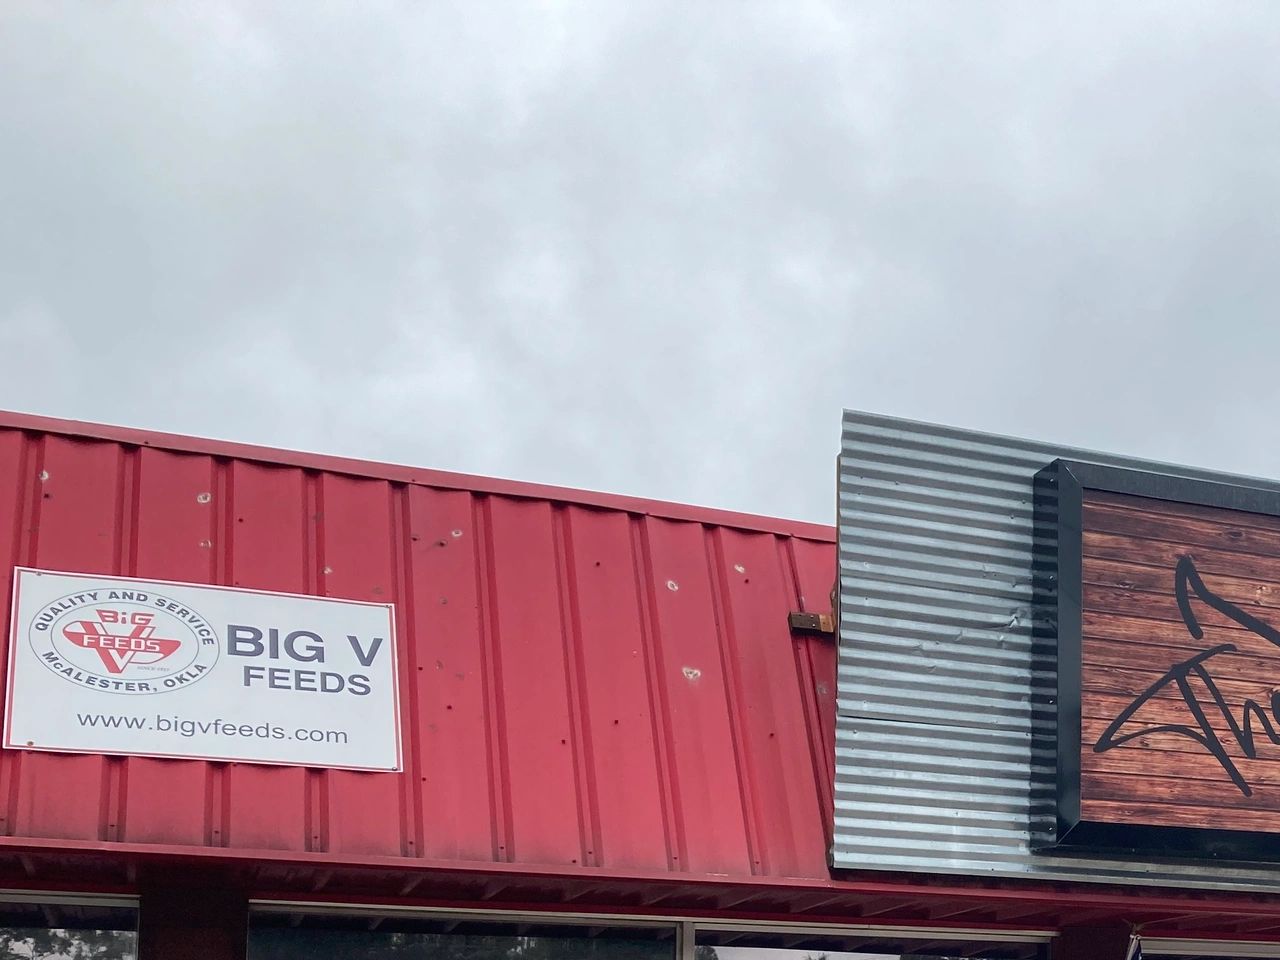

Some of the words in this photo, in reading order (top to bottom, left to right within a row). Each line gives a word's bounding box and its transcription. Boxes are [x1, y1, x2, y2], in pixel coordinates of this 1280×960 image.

[35, 592, 98, 632] QUALITY
[108, 591, 148, 602] AND
[155, 598, 215, 646] SERVICE
[83, 635, 161, 651] FEEDS
[227, 624, 326, 664] BIG
[347, 634, 384, 668] V
[163, 664, 208, 688] OKLA
[243, 665, 372, 696] FEEDS
[76, 712, 348, 744] www.bigvfeeds.com
